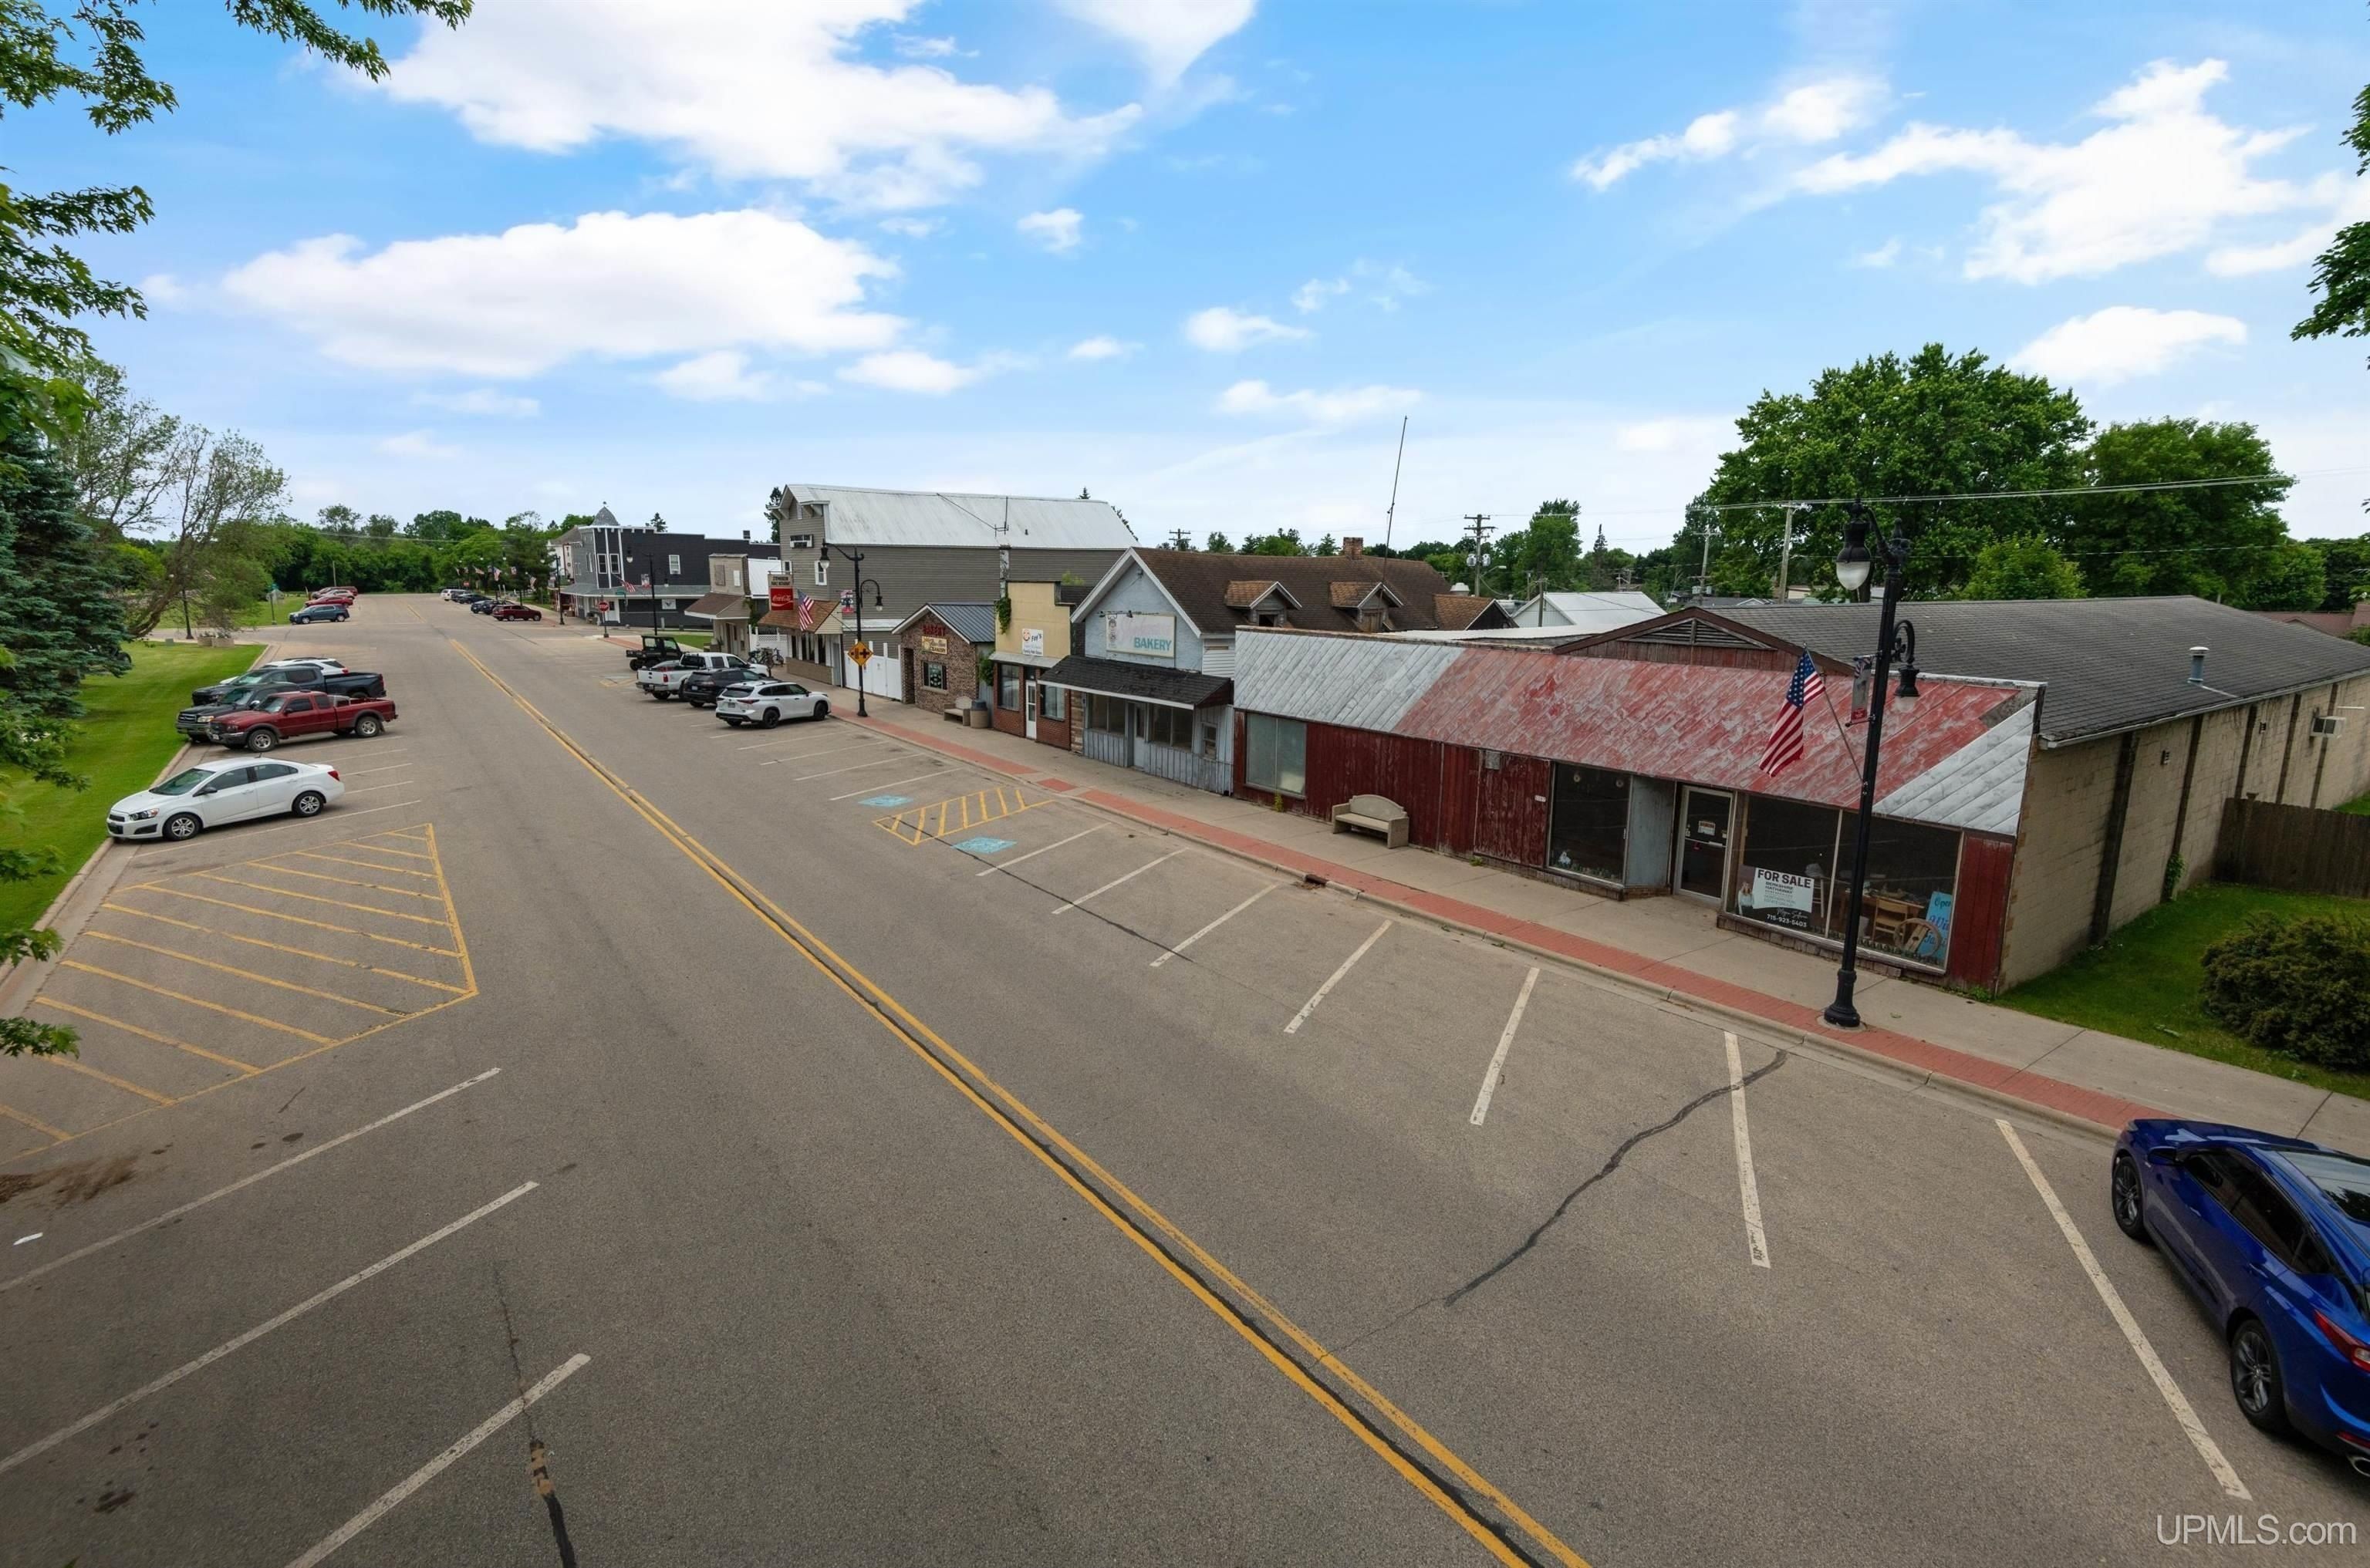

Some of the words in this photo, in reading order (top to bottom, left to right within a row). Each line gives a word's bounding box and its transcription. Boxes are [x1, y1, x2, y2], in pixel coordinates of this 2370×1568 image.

[1134, 637, 1172, 651] BAKERY
[1757, 869, 1780, 882] FOR
[1782, 874, 1811, 889] SALE
